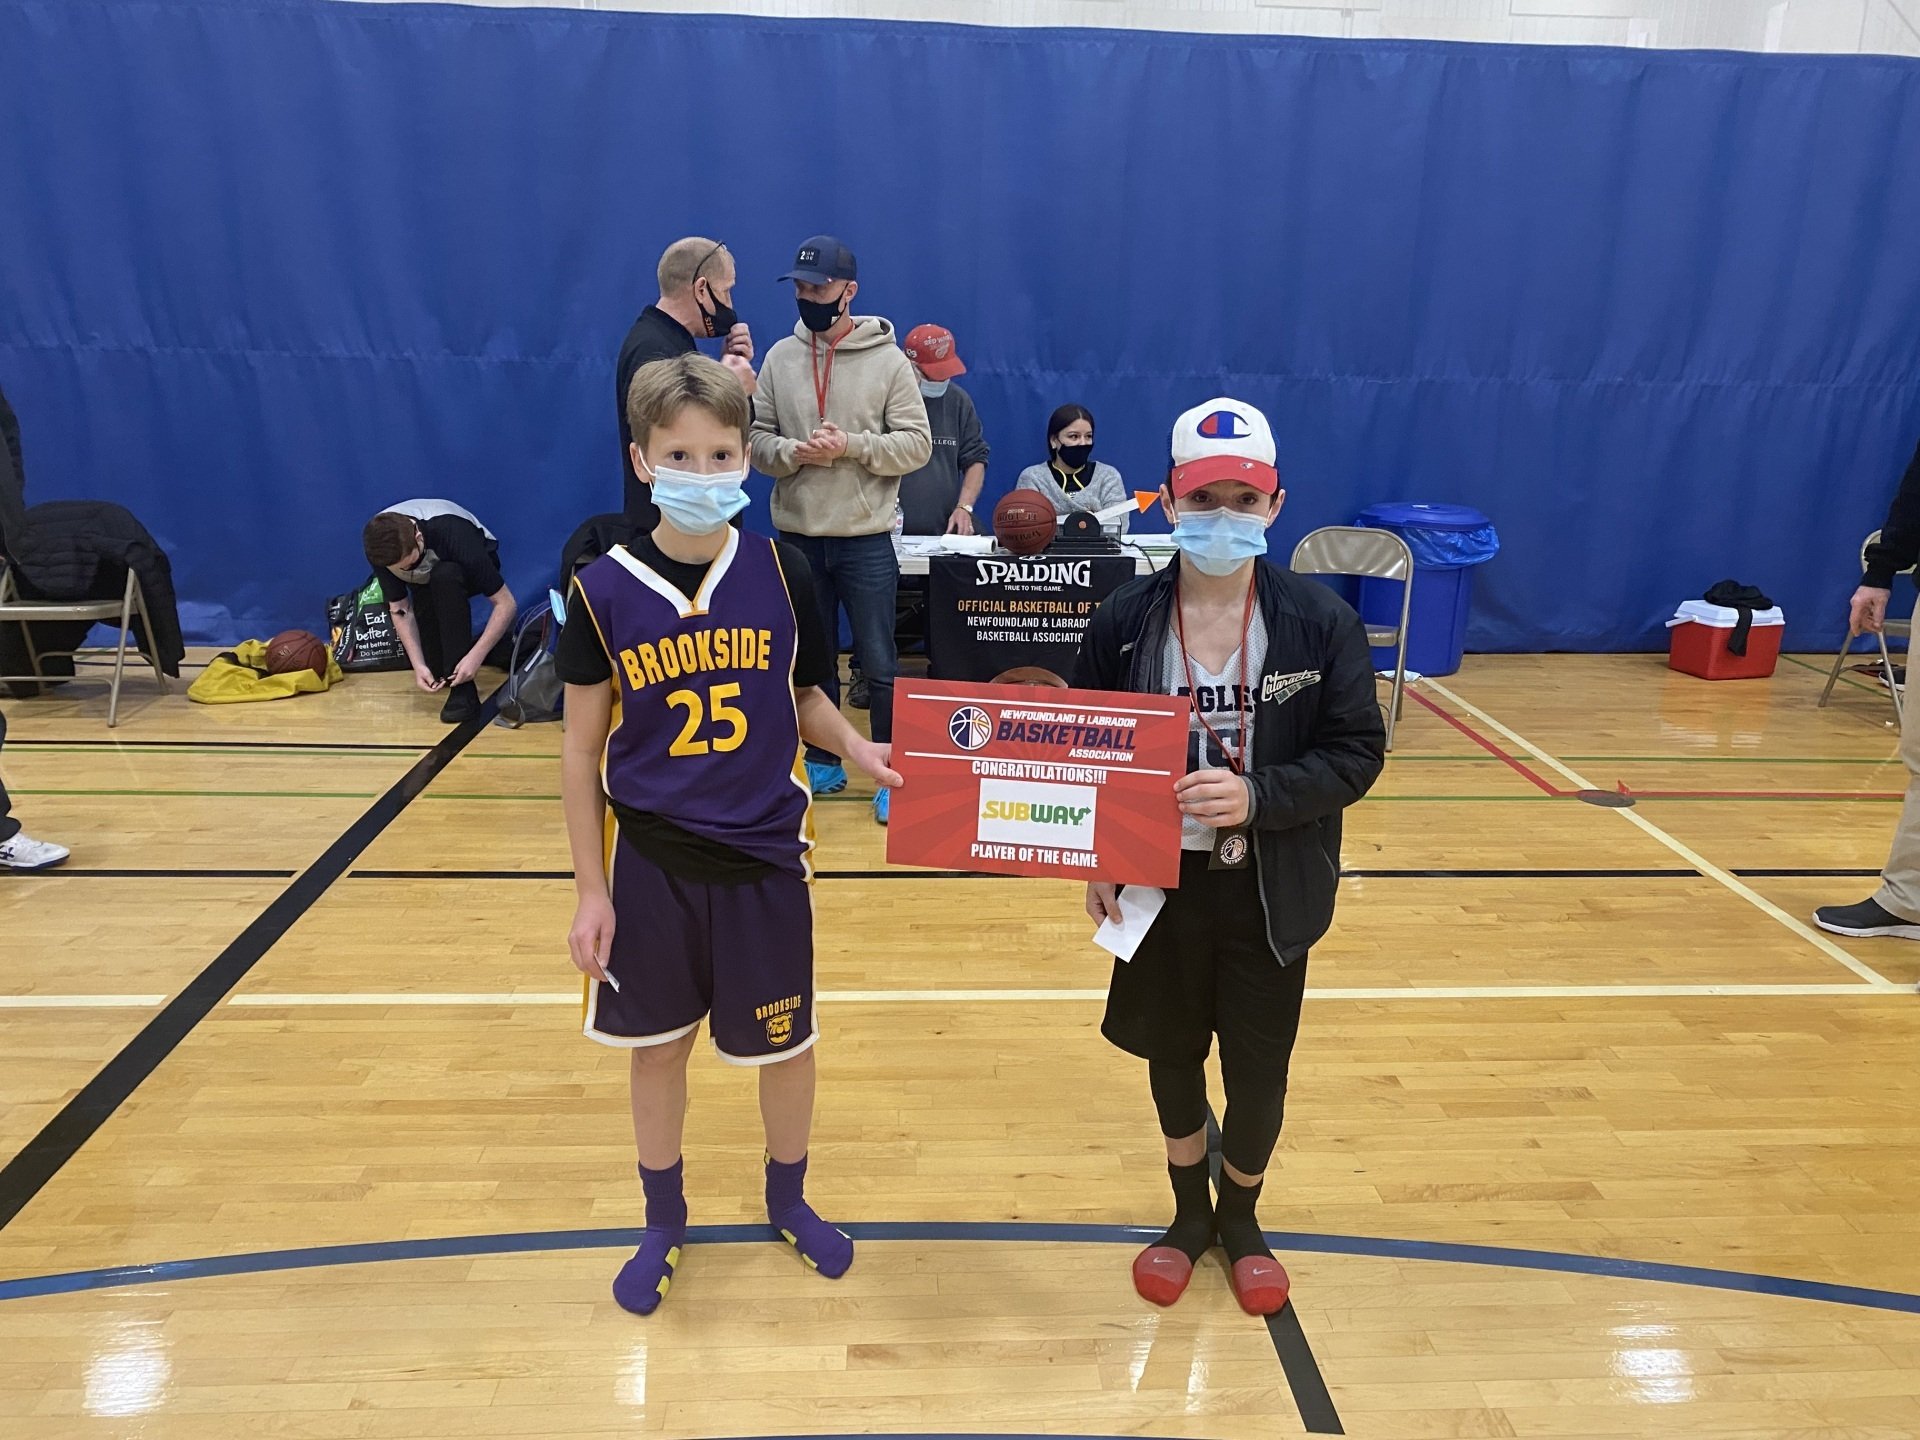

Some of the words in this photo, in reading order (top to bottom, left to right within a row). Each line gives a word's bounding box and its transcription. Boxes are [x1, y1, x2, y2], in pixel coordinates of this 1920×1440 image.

[975, 559, 1091, 588] SPALDING
[364, 611, 387, 626] Eat
[958, 600, 1007, 613] OFFICIAL
[1009, 600, 1074, 614] BASKETBALL
[1077, 601, 1091, 614] OF
[355, 626, 390, 642] better.
[967, 616, 1039, 628] NEWFOUNDLAND
[1042, 617, 1049, 628] &
[355, 642, 369, 650] Feel
[370, 640, 391, 649] better.
[976, 630, 1030, 643] BASKETBALL
[1032, 631, 1084, 644] ASSOCIATIO
[619, 628, 772, 691] BROOKSIDE
[1261, 669, 1320, 703] Cataracts
[665, 681, 748, 757] 25
[1000, 708, 1076, 724] NEWFOUNDLAND
[1077, 714, 1085, 725] &
[1087, 714, 1137, 728] LABRADOR
[996, 720, 1137, 751] BASKETBALL
[1068, 748, 1134, 763] ASSOCIATION
[972, 760, 1107, 785] CONGRATULATIONS!!!
[981, 800, 1092, 826] SUBWAY
[971, 843, 1016, 861] PLAYER
[1018, 847, 1035, 863] OF
[1036, 848, 1060, 866] THE
[1062, 851, 1098, 868] GAME
[755, 994, 802, 1021] BROOKSIDE
